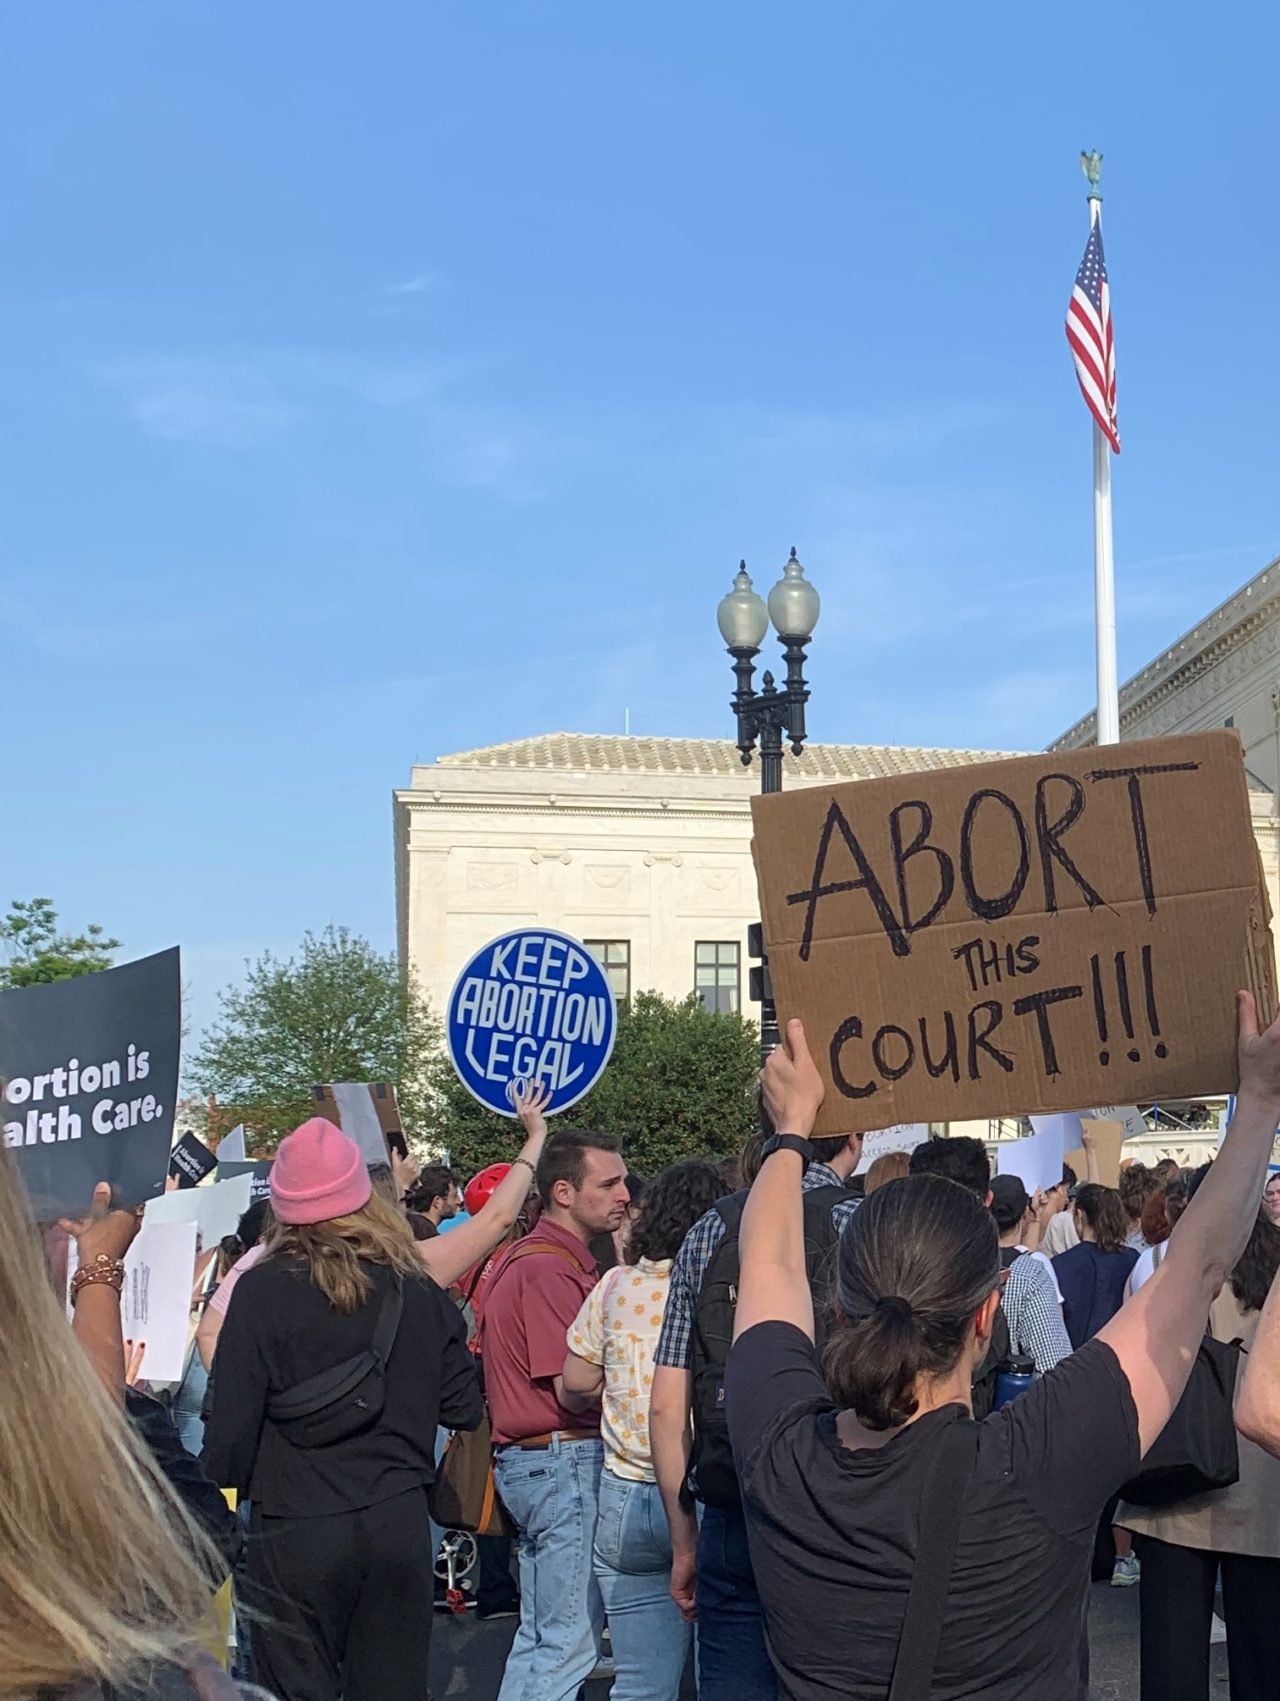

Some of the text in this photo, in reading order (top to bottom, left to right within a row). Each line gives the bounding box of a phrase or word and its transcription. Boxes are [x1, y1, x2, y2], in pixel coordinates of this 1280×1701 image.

[786, 762, 1201, 961] ABORT
[490, 936, 590, 989] KEEP
[953, 935, 1040, 991] THIS
[457, 977, 606, 1047] ABORTION
[829, 944, 1169, 1100] COURT!!!
[6, 1043, 150, 1104] ortion is
[465, 1028, 585, 1091] LEGAL
[2, 1094, 163, 1148] alth Care.
